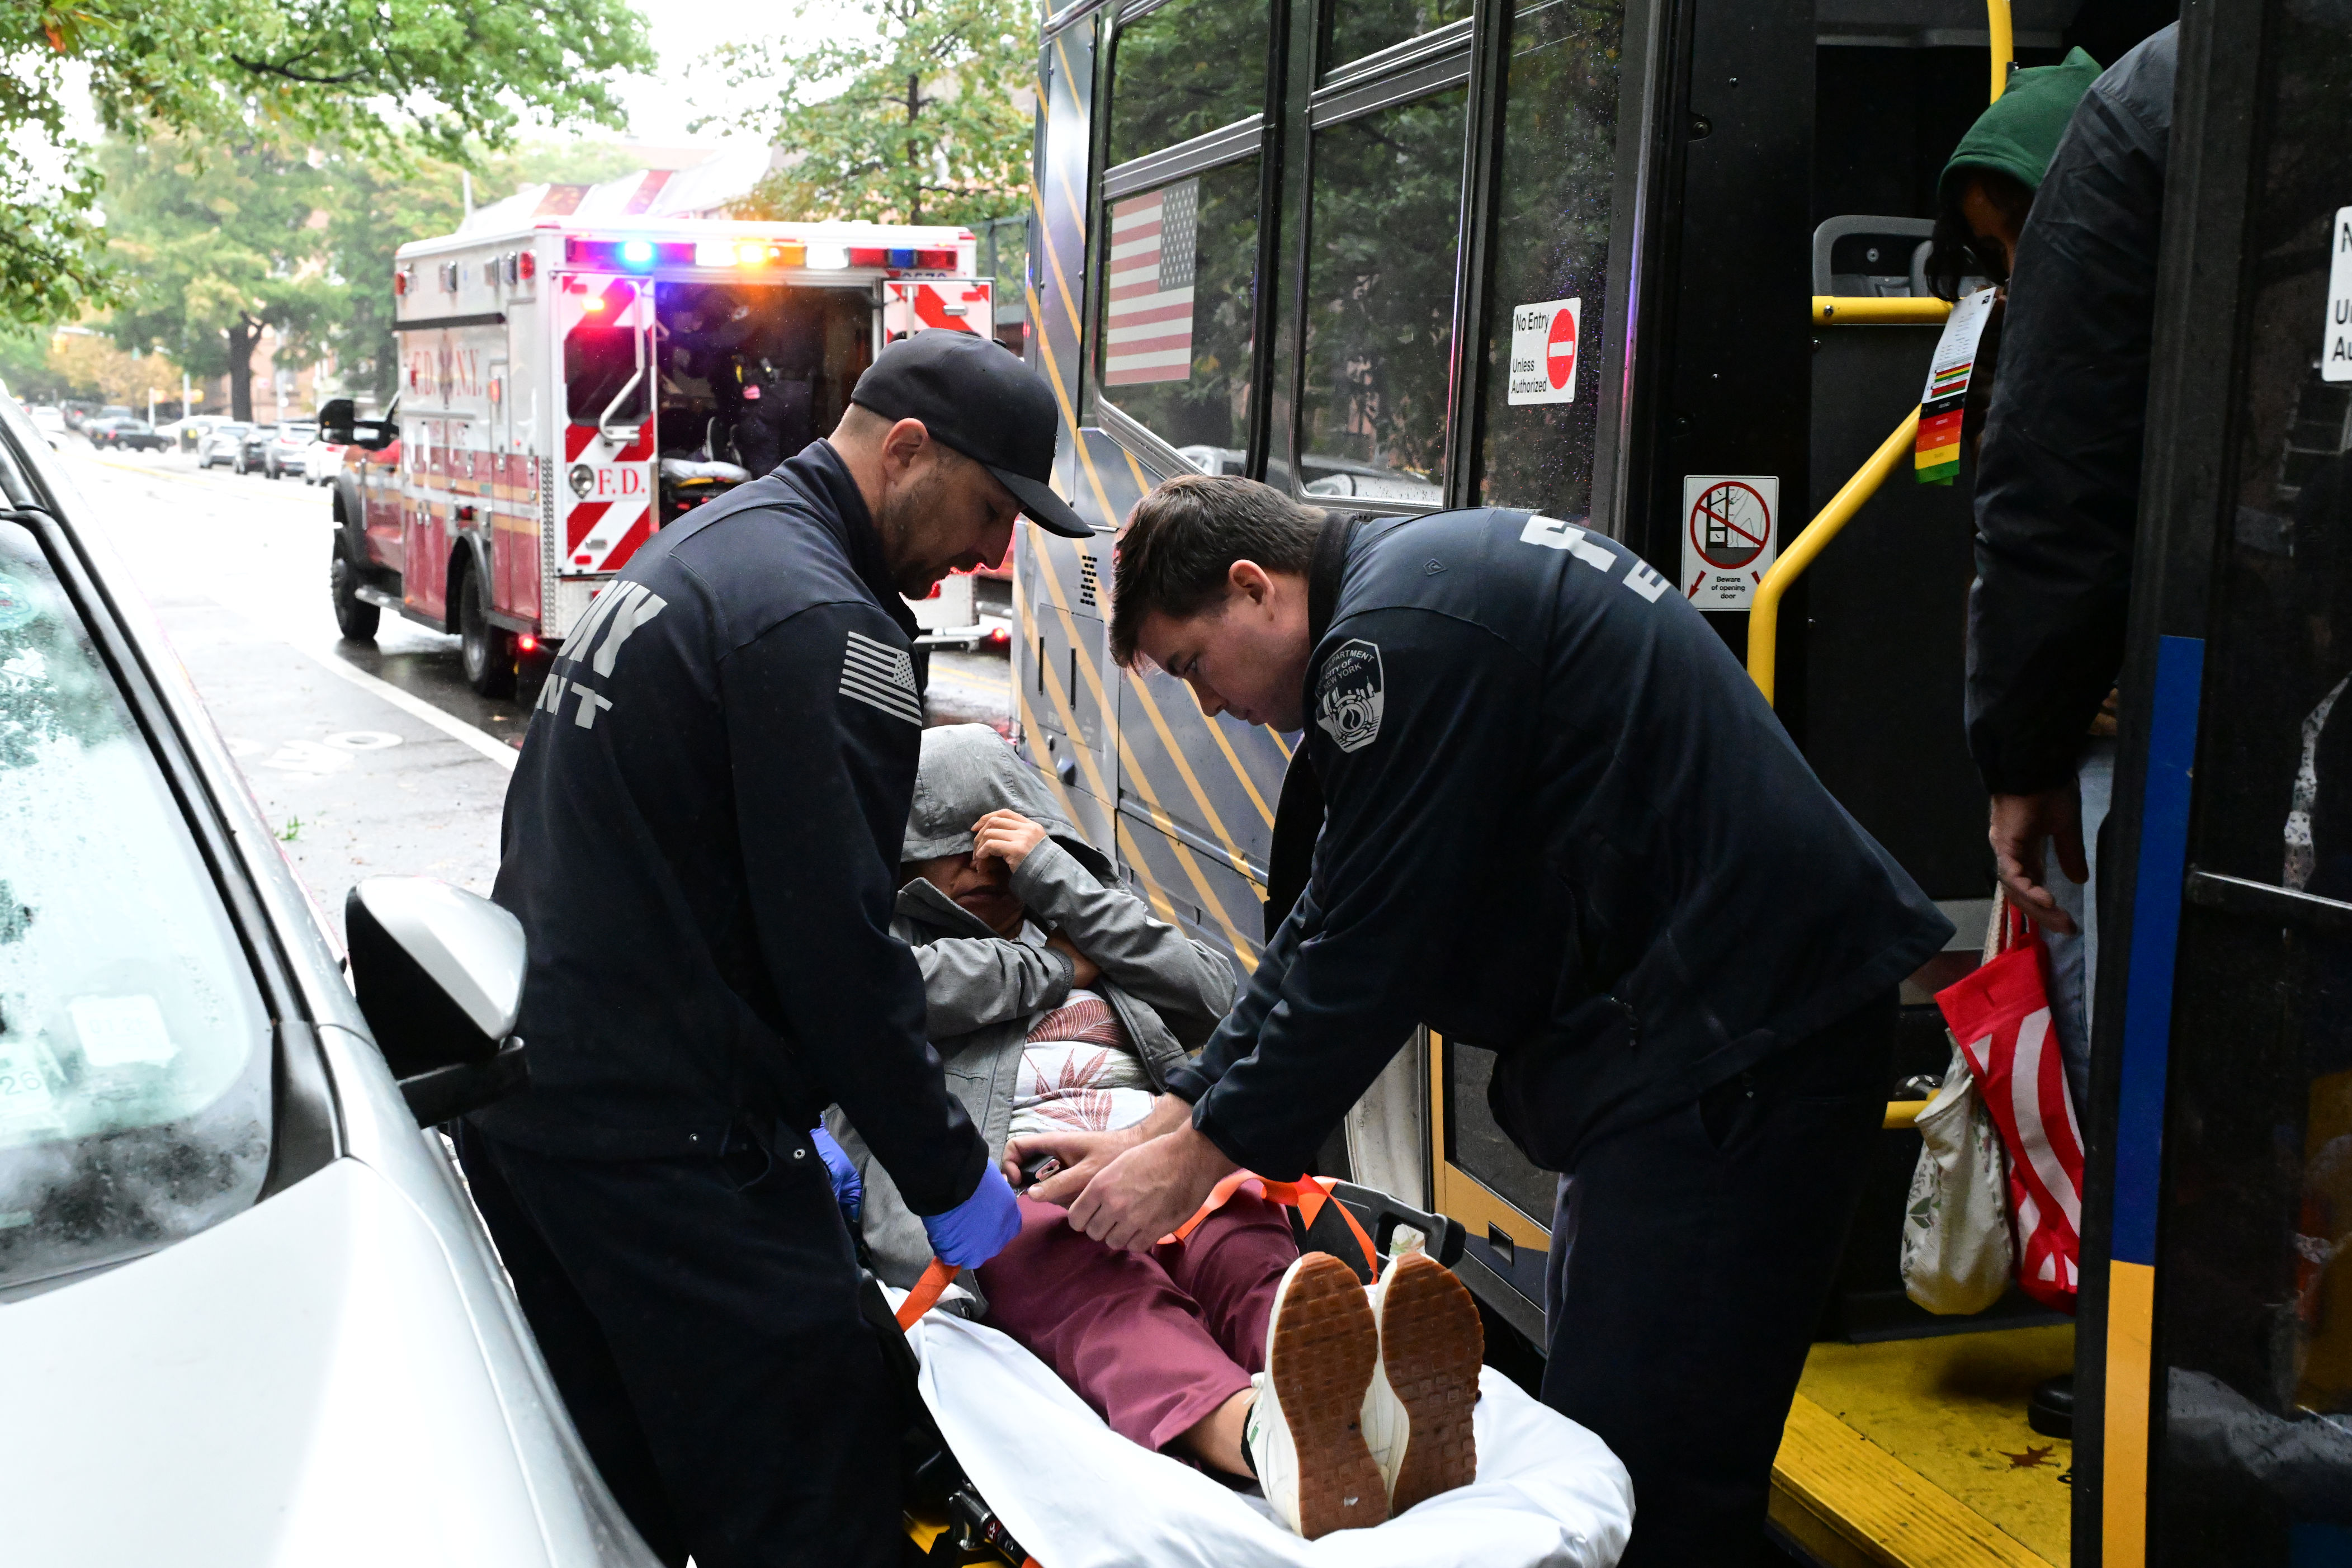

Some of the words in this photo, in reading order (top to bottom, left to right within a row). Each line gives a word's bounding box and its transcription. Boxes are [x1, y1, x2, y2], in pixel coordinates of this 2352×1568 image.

[1515, 313, 1526, 332] No
[1528, 312, 1550, 334] Entry
[1513, 357, 1535, 373] Unless
[1511, 377, 1547, 394] Authorized
[598, 467, 645, 495] F.D.
[1325, 664, 1340, 679] CITY
[1341, 658, 1353, 669] OF
[1337, 662, 1362, 679] YORK
